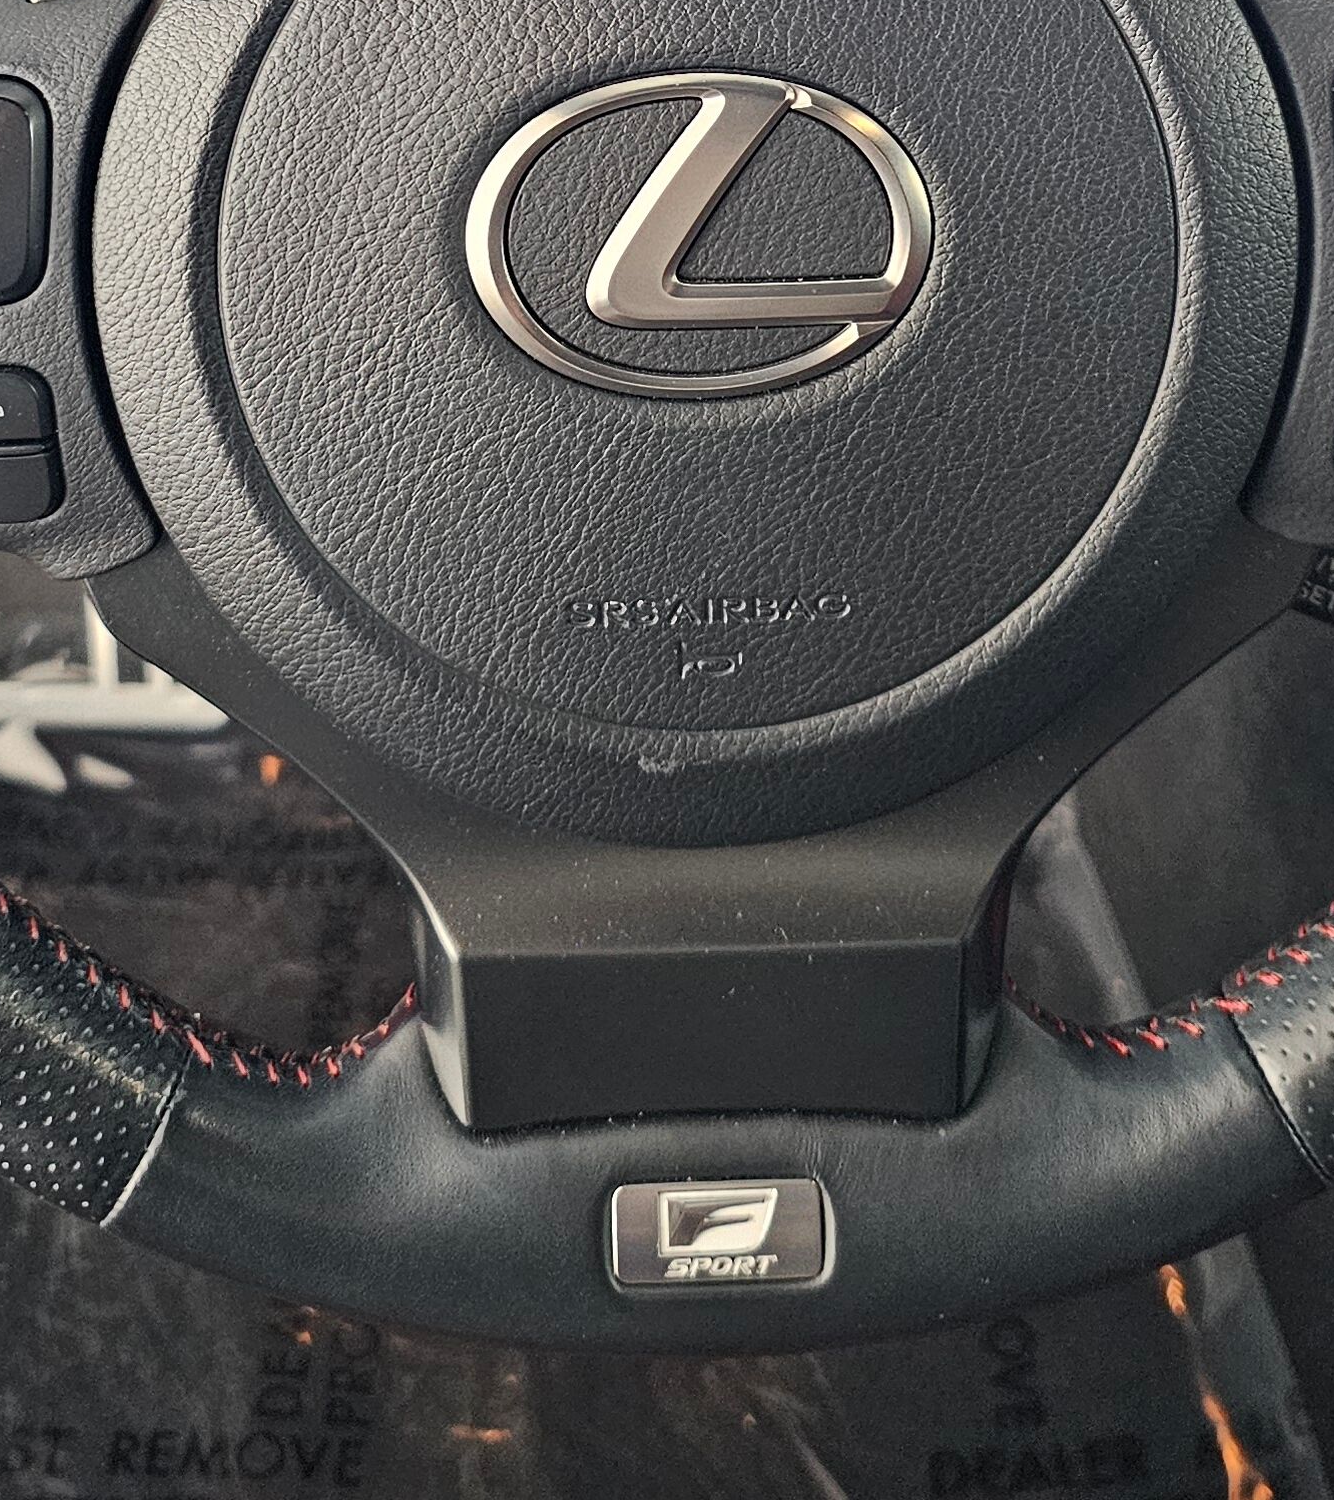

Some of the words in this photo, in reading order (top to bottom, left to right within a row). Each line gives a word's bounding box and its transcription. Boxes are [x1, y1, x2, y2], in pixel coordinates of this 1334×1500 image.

[571, 598, 660, 629] SRS
[667, 593, 852, 627] AIRBAG
[664, 1254, 779, 1279] SPORT
[108, 1428, 366, 1487] REMOVE
